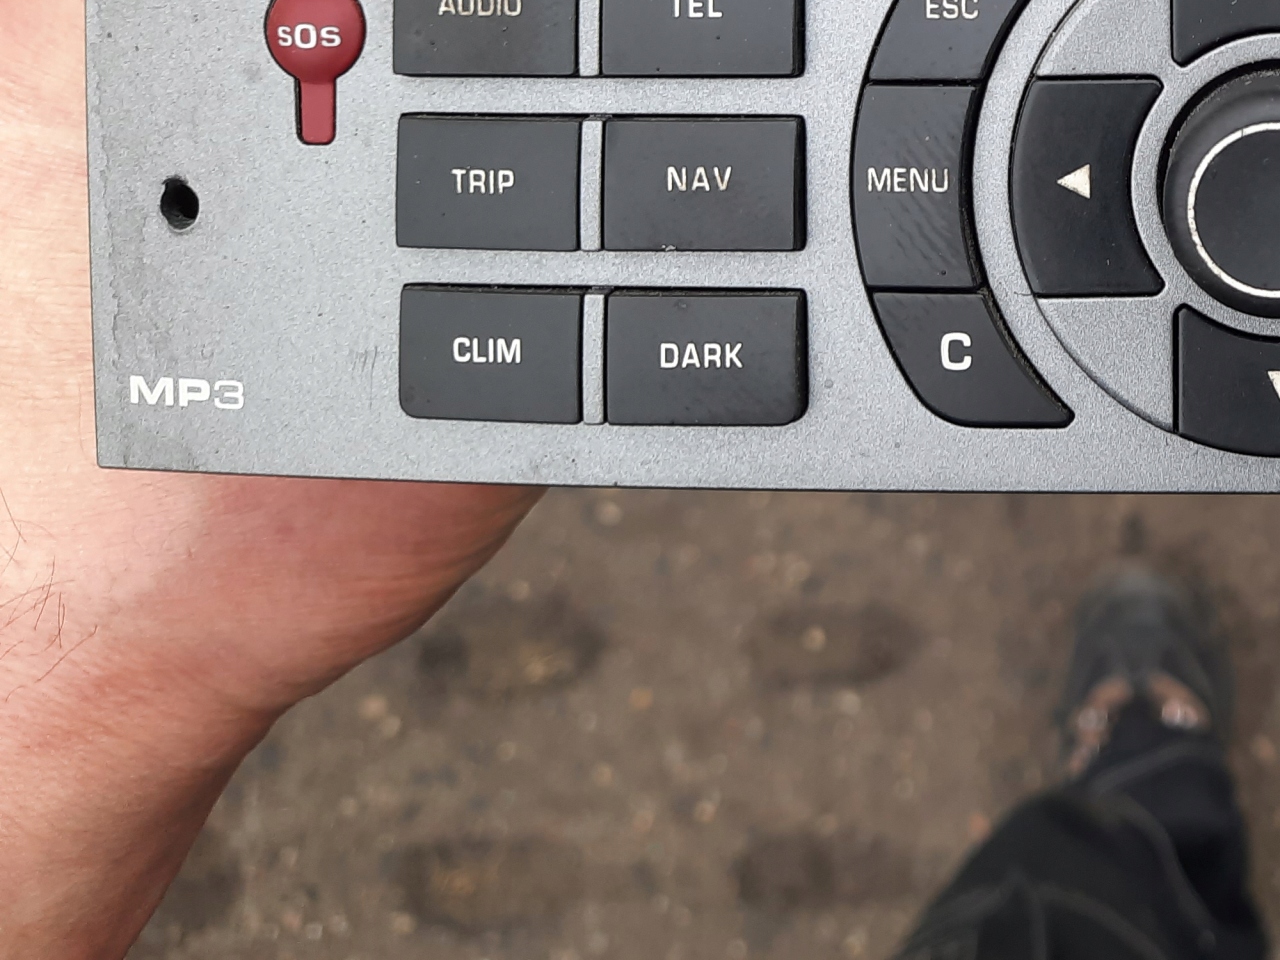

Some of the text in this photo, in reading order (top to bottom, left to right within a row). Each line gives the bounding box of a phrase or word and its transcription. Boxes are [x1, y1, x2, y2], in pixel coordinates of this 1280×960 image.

[277, 23, 341, 49] SOS
[451, 168, 515, 195] TRIP
[667, 166, 732, 192] NAV
[867, 167, 949, 193] MENU
[452, 336, 521, 364] CLIM
[660, 342, 743, 369] DARK
[940, 332, 972, 371] C
[129, 375, 245, 410] MP3
